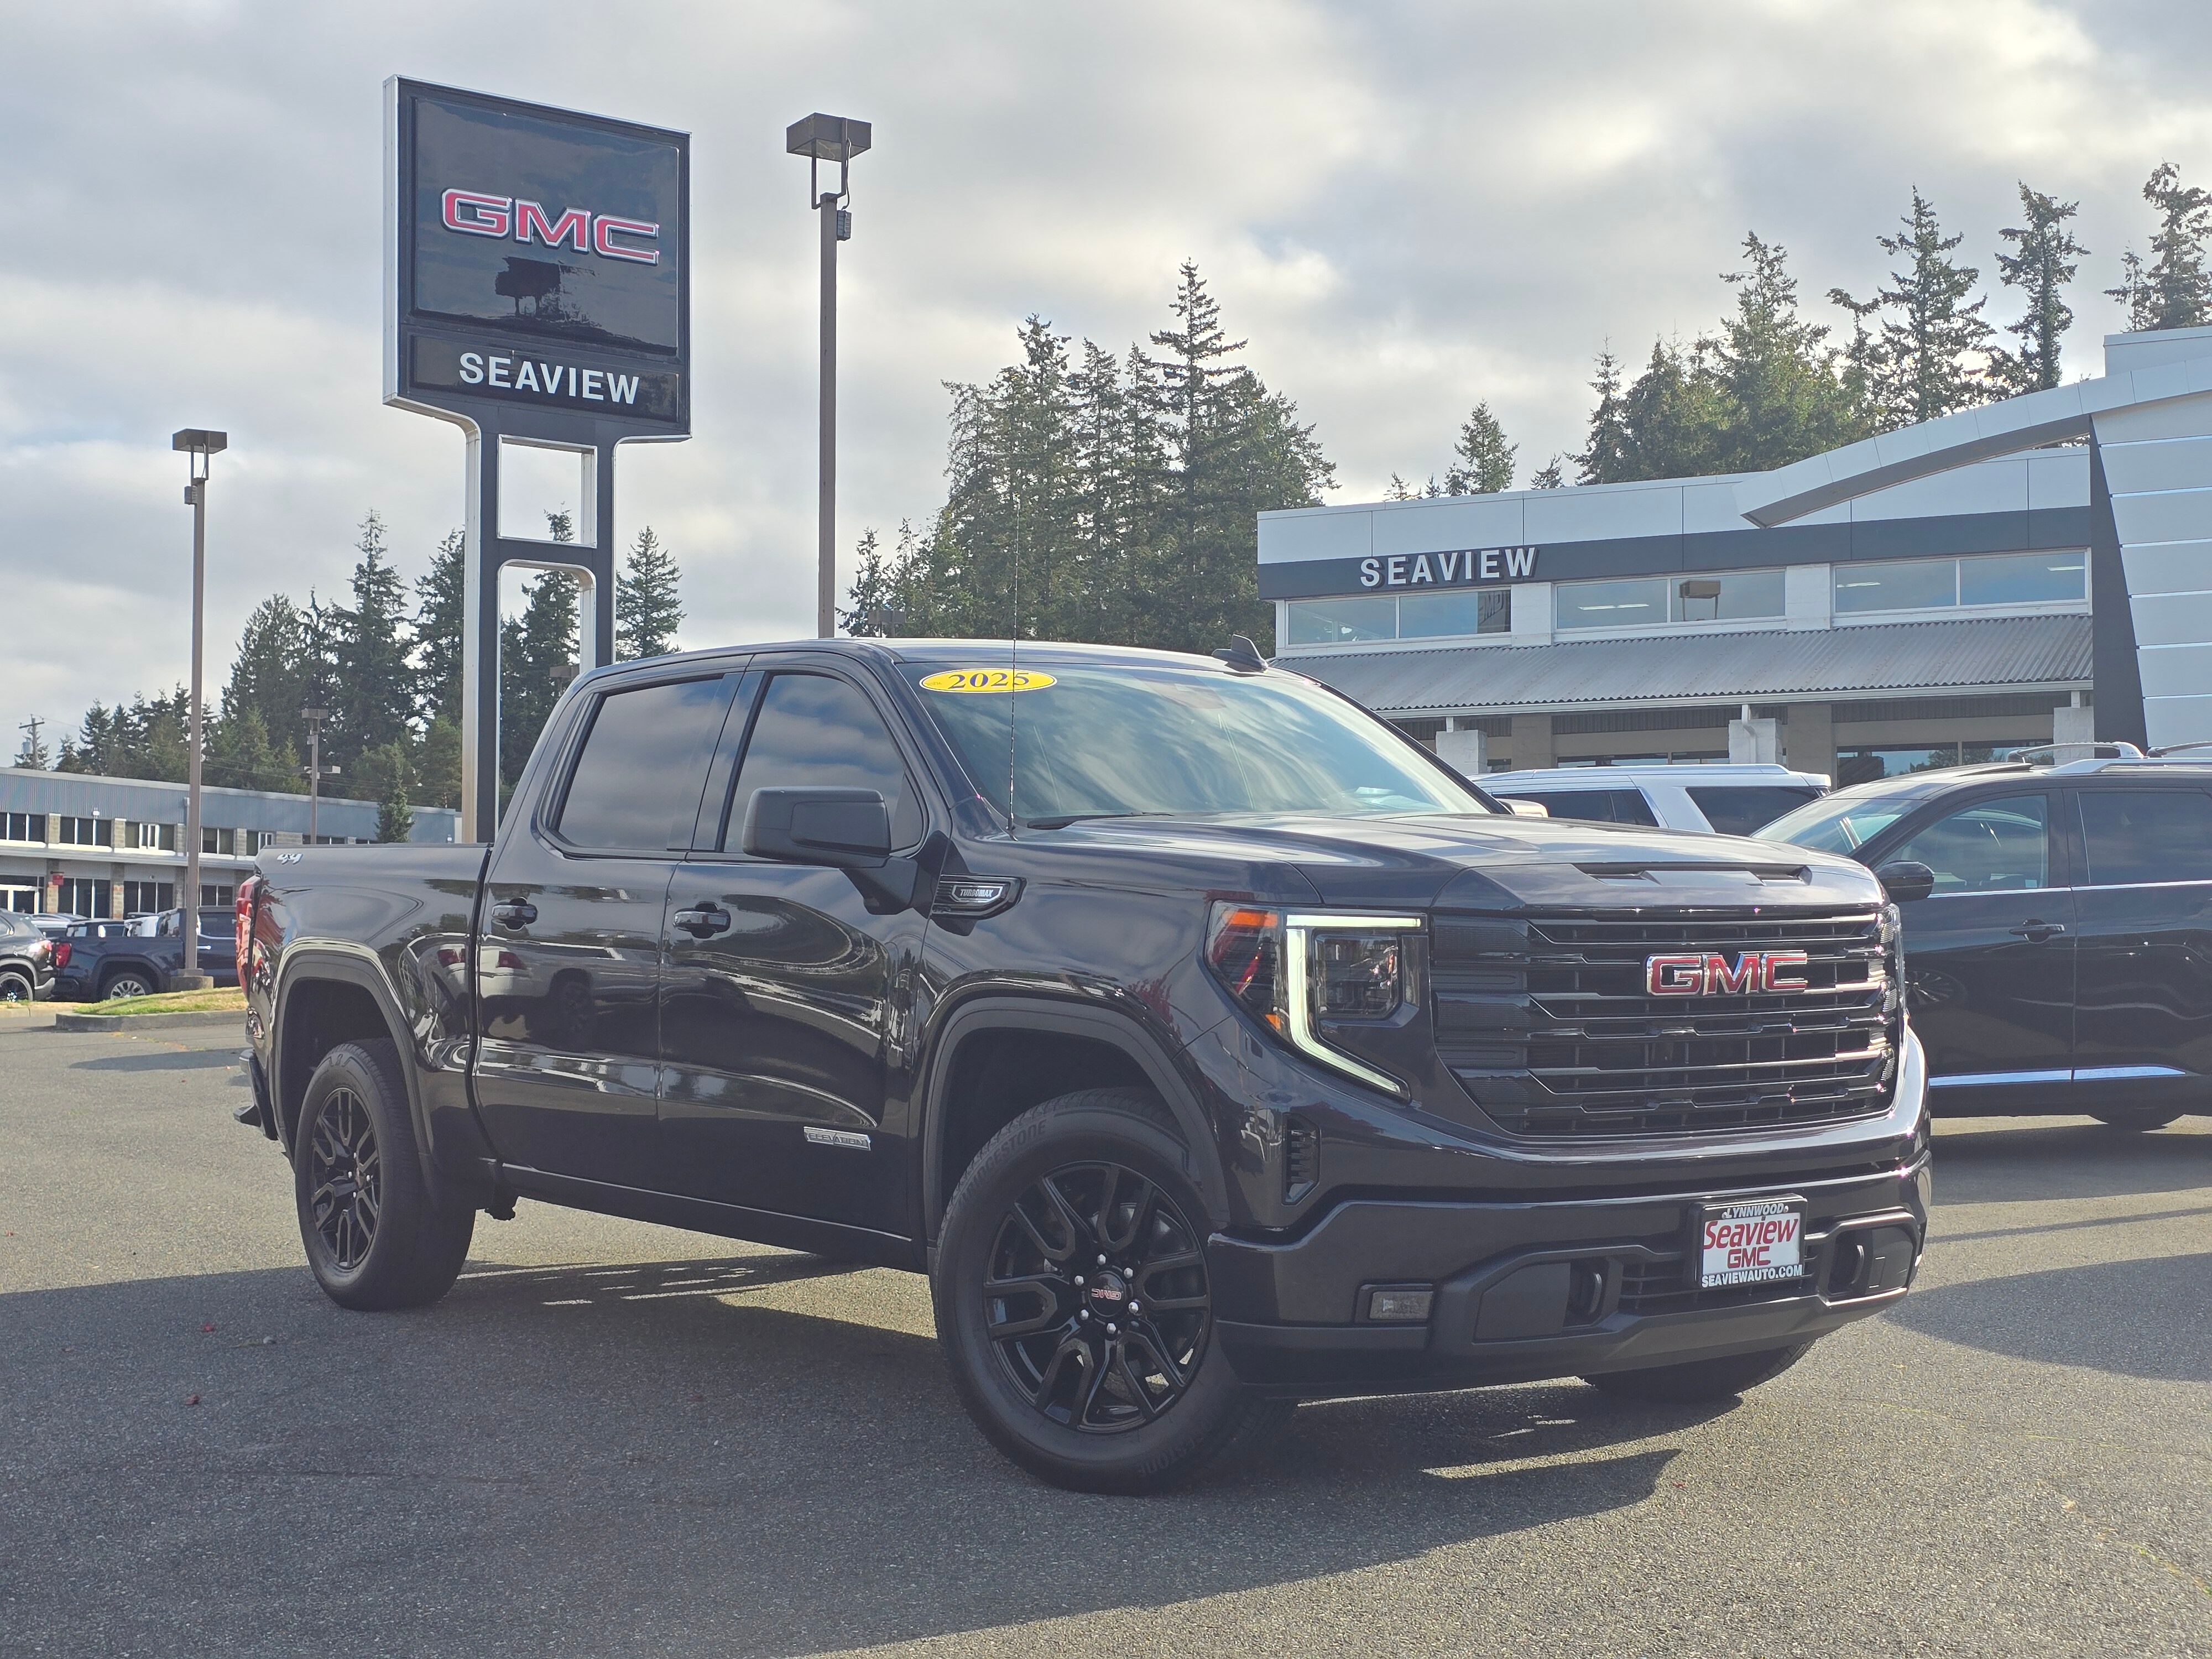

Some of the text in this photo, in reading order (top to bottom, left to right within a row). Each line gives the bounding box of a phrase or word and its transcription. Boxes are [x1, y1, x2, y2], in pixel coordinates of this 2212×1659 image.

[442, 188, 660, 265] GMC
[458, 352, 639, 404] SEAVIEW
[1360, 547, 1536, 587] SEAVIEW
[947, 672, 1030, 689] 2025
[960, 889, 994, 897] TURBOMAX
[1646, 952, 1808, 995] GMC
[808, 1133, 867, 1146] ELEVATION
[1725, 1203, 1784, 1219] LYNNWOOD
[1703, 1217, 1798, 1250] Seaview
[1727, 1246, 1771, 1269] GMC
[1702, 1265, 1802, 1288] SEAVIEWAUTO.COM
[1091, 1288, 1121, 1301] GMC
